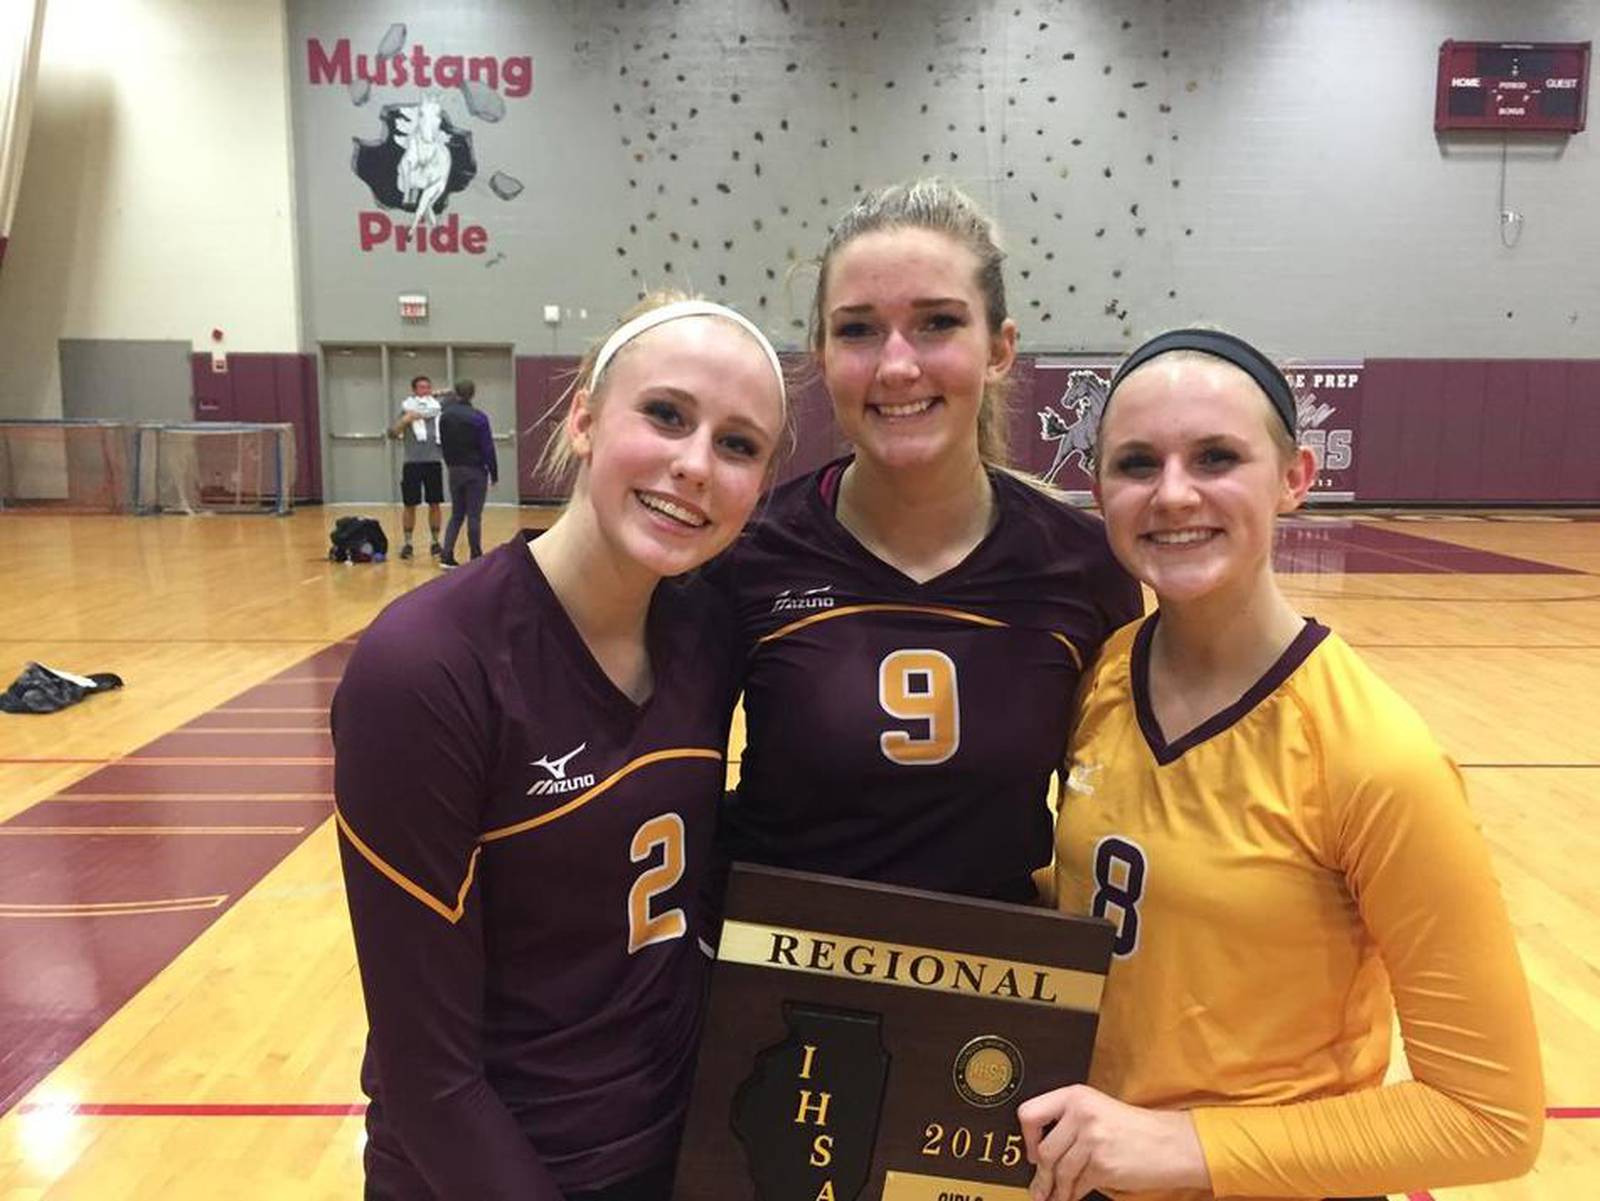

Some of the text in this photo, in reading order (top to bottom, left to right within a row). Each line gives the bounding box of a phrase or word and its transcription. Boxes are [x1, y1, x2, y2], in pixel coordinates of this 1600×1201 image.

[307, 38, 533, 98] Mustang
[1451, 77, 1579, 88] HOME GUEST
[358, 211, 488, 256] Pride
[1313, 373, 1359, 389] PREP
[1297, 429, 1353, 471] GS
[878, 648, 961, 767] 9
[526, 773, 596, 796] MIZUNO
[627, 811, 688, 956] 2
[1091, 834, 1148, 960] 8
[767, 931, 1058, 1004] REGIONAL
[922, 1123, 1024, 1168] 2015
